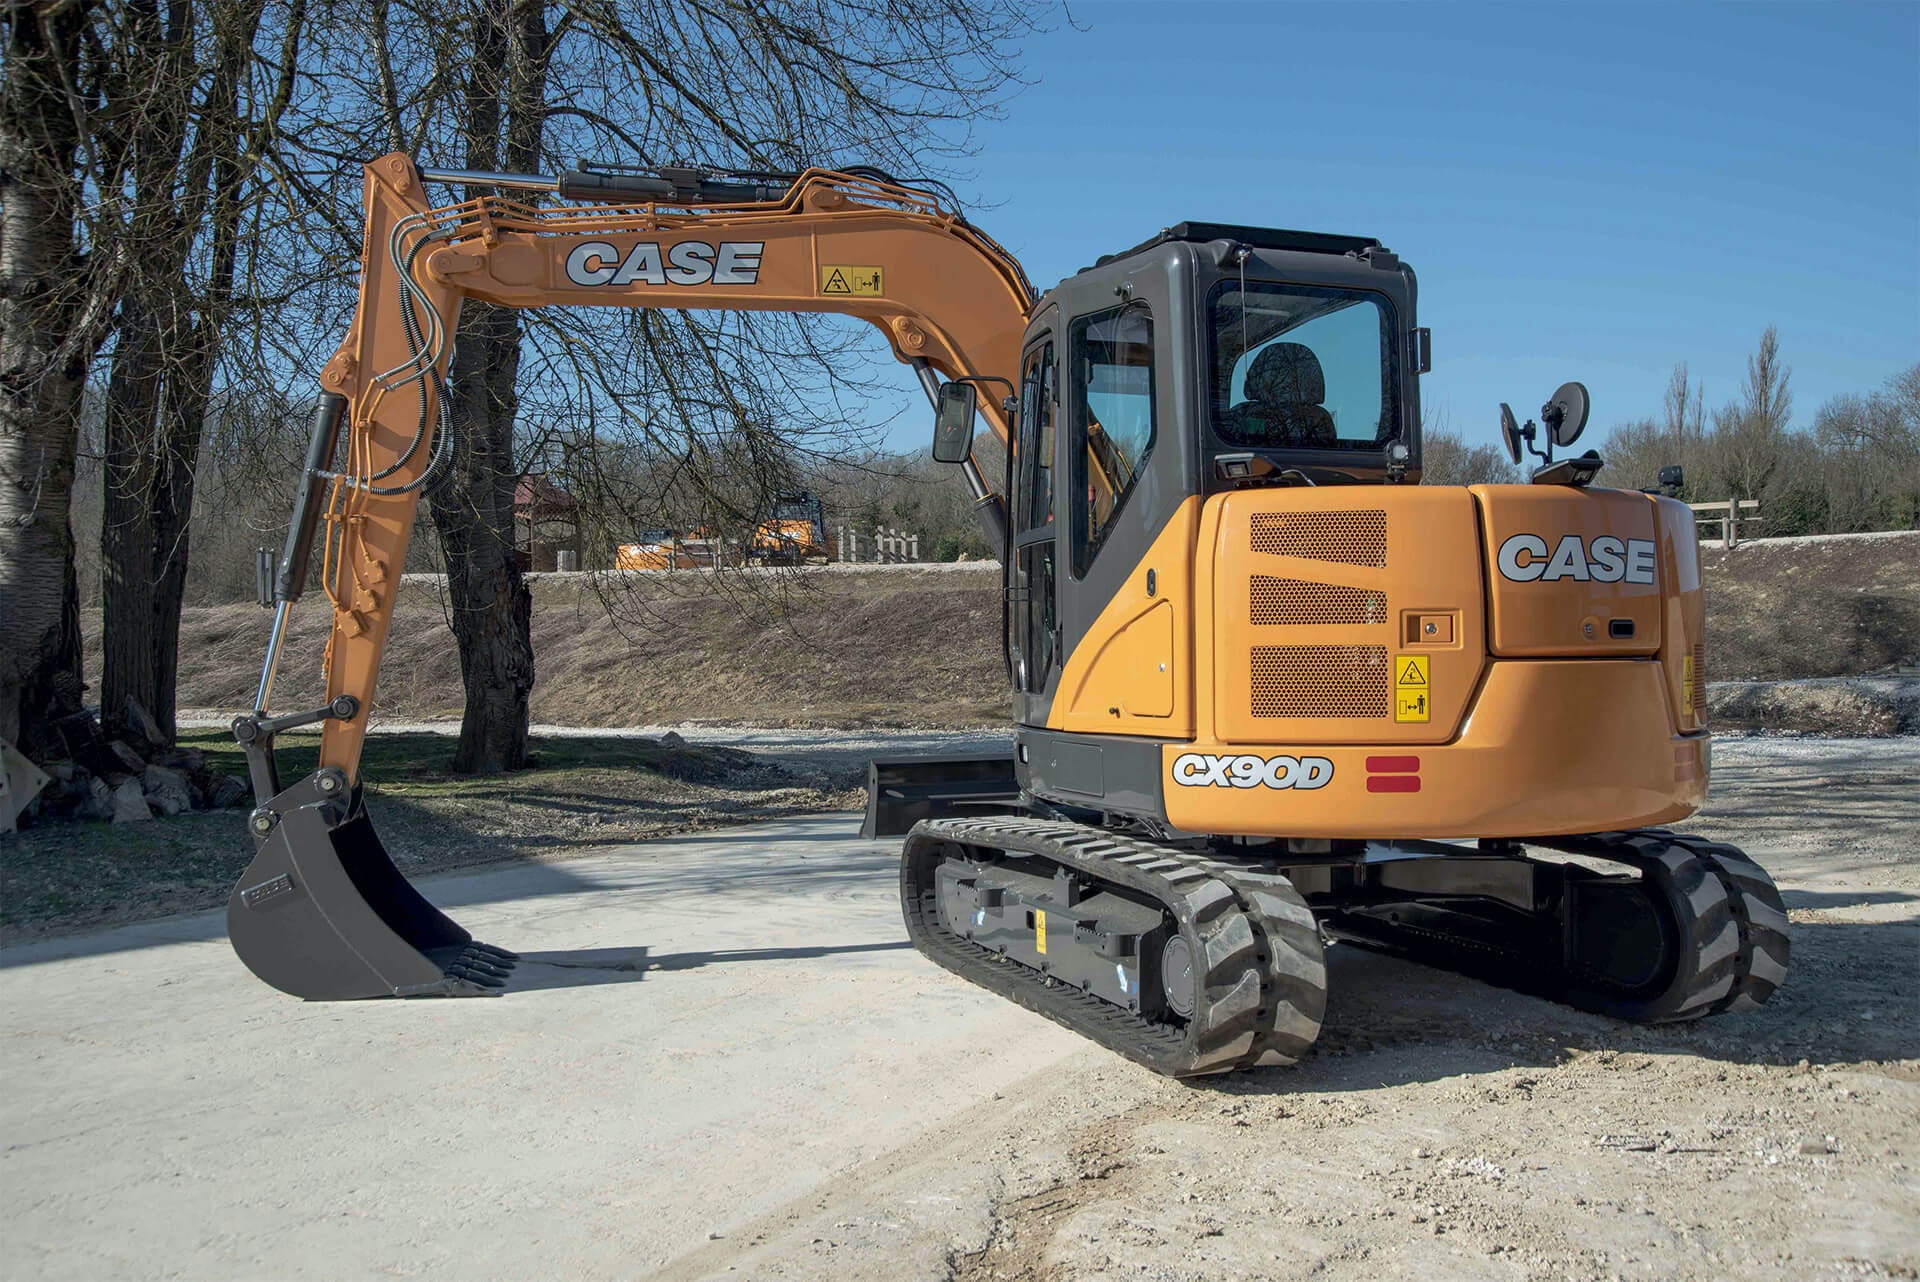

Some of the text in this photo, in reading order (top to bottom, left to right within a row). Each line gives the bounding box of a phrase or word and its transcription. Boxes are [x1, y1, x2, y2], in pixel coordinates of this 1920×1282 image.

[565, 241, 765, 287] CASE
[1497, 533, 1656, 585] CASE
[1172, 753, 1335, 790] CX90D
